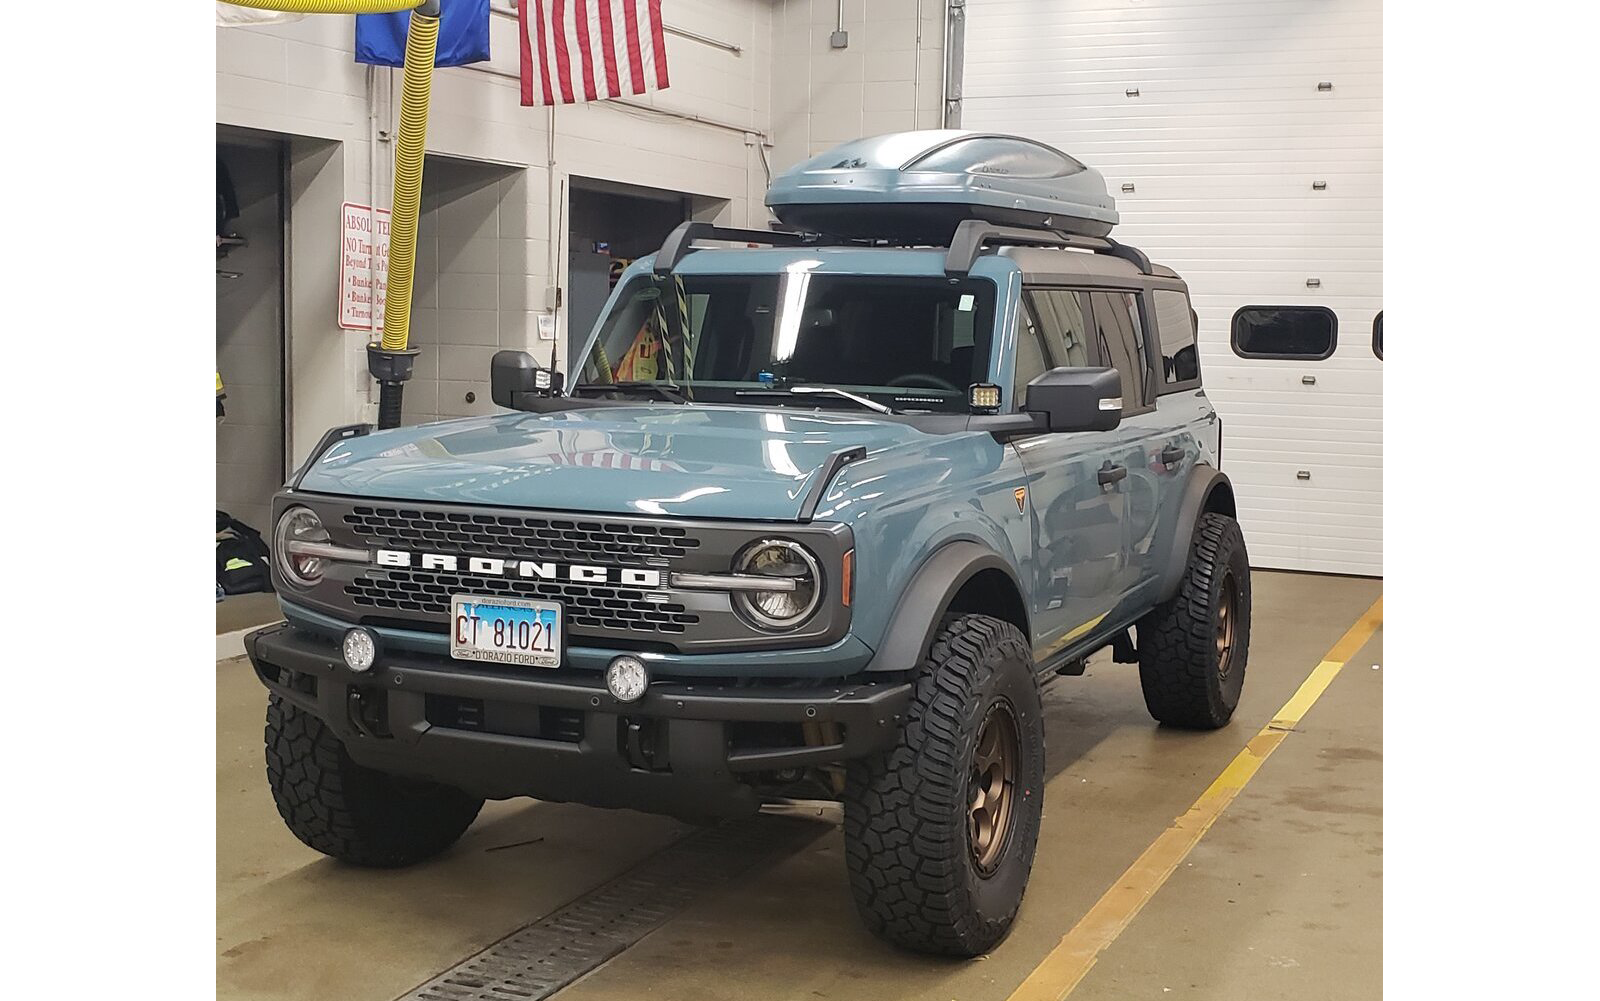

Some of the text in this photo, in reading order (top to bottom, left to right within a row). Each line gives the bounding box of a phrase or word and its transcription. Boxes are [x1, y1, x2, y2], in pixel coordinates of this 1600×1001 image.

[346, 237, 357, 253] NO
[345, 255, 366, 270] Beyond
[377, 549, 660, 587] BRONCO
[457, 615, 554, 652] CT 81021
[475, 650, 535, 665] D'ORAZIO FORD
